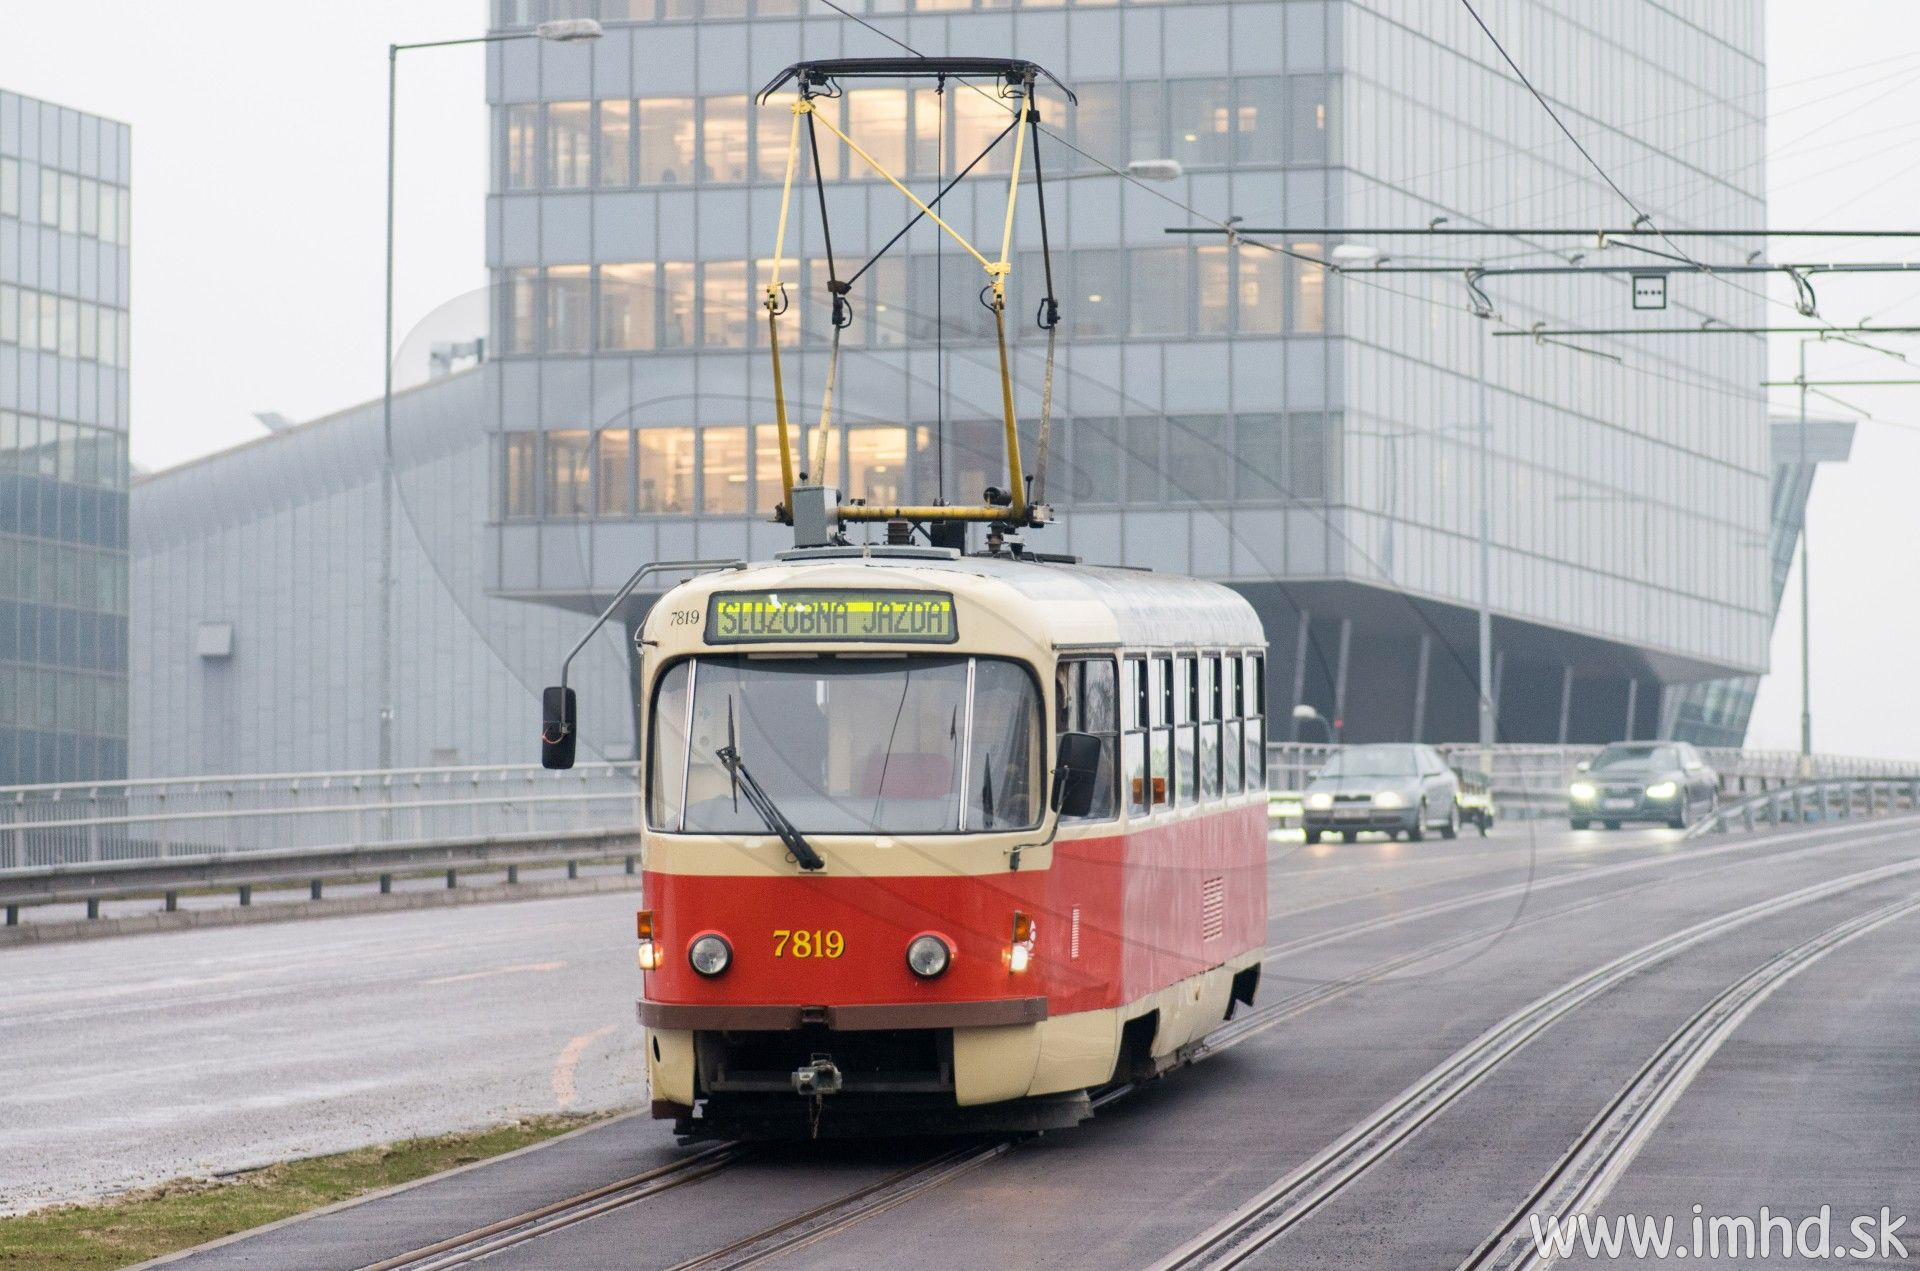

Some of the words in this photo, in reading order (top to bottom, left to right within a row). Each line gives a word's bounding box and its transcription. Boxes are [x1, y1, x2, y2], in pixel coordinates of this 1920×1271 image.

[670, 610, 700, 626] 7819
[862, 600, 944, 634] JAZDA
[772, 930, 845, 958] 7819
